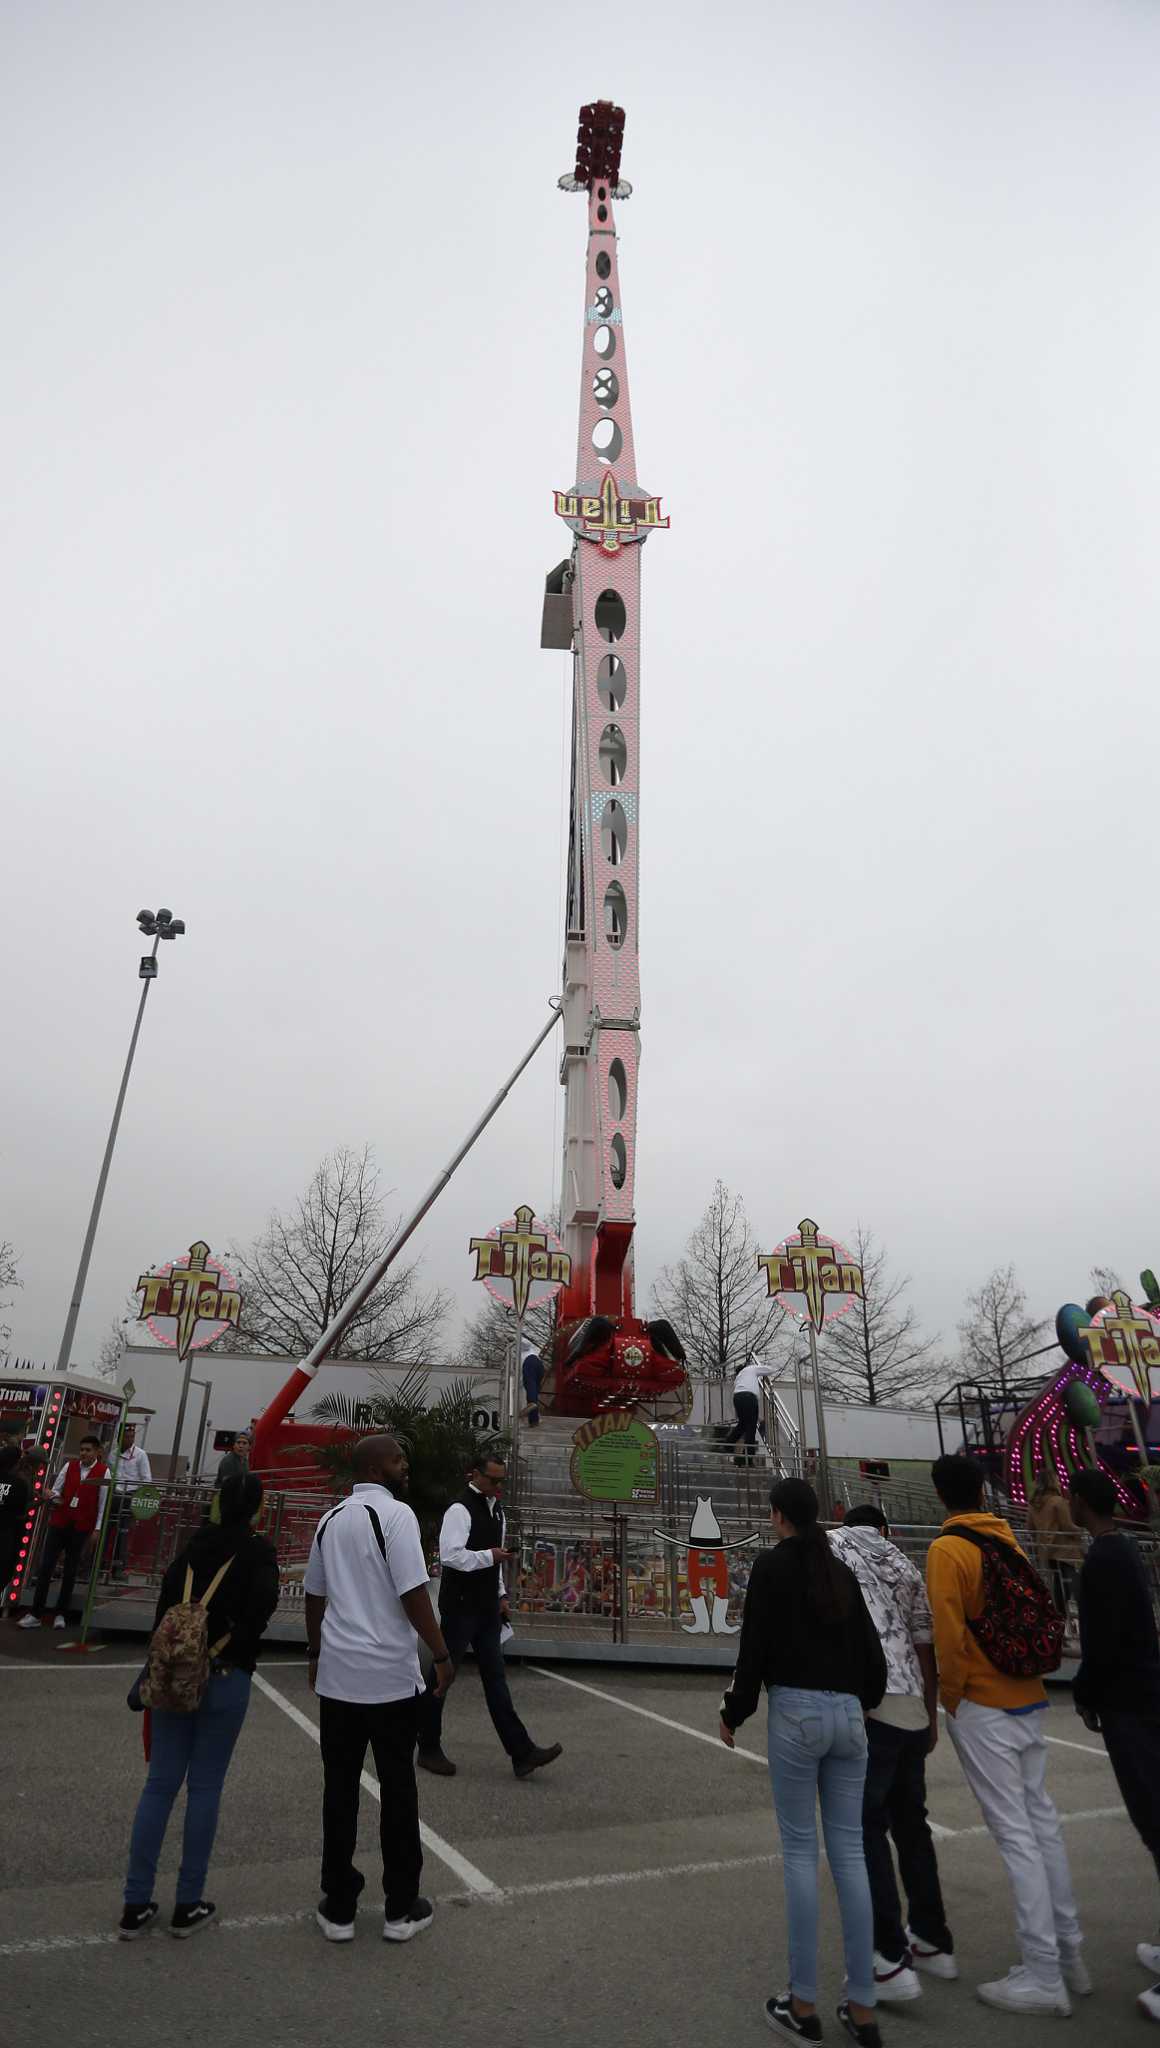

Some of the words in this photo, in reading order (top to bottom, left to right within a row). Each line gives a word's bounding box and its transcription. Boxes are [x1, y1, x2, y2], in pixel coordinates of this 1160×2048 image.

[137, 1267, 243, 1361] Titan
[468, 1231, 572, 1320] Titan
[757, 1245, 868, 1336] Titan
[131, 1497, 160, 1509] ENTER
